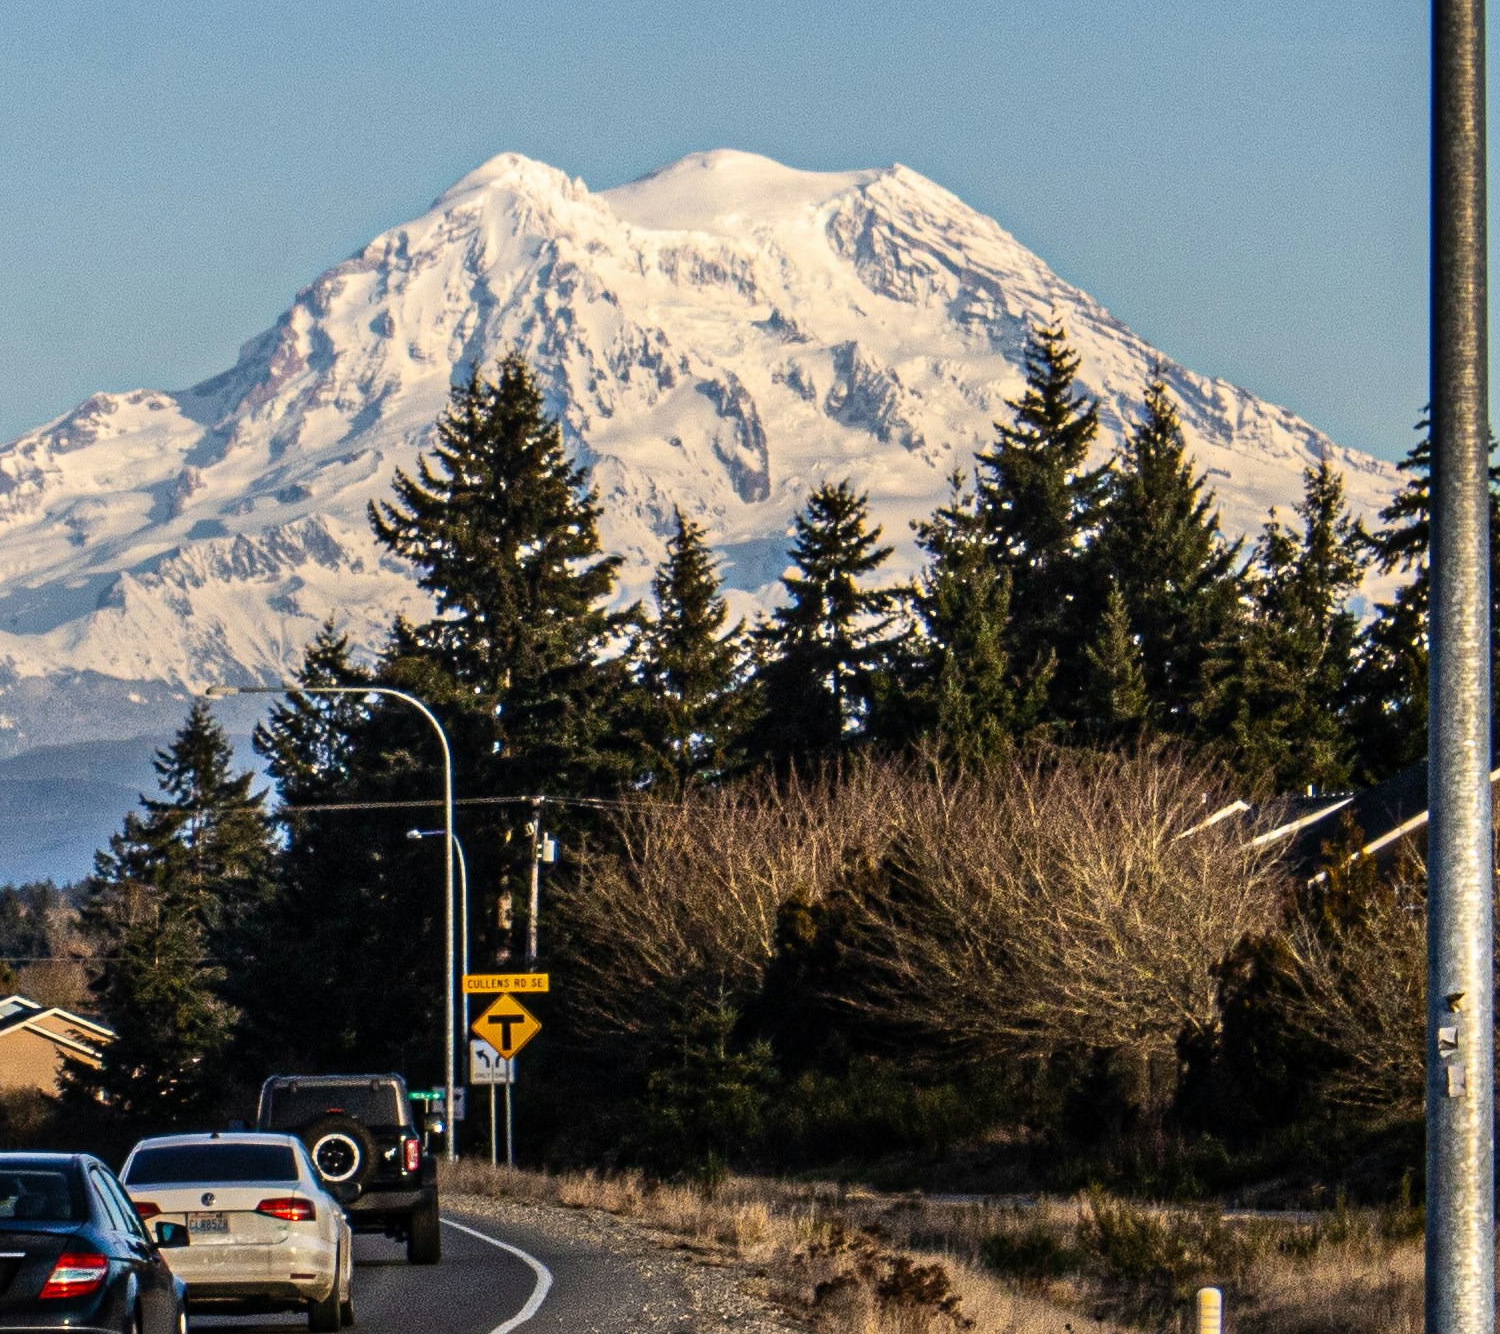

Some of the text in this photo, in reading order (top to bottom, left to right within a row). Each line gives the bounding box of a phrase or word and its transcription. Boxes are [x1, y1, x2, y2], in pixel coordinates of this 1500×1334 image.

[467, 977, 543, 989] CULLENS RD SE
